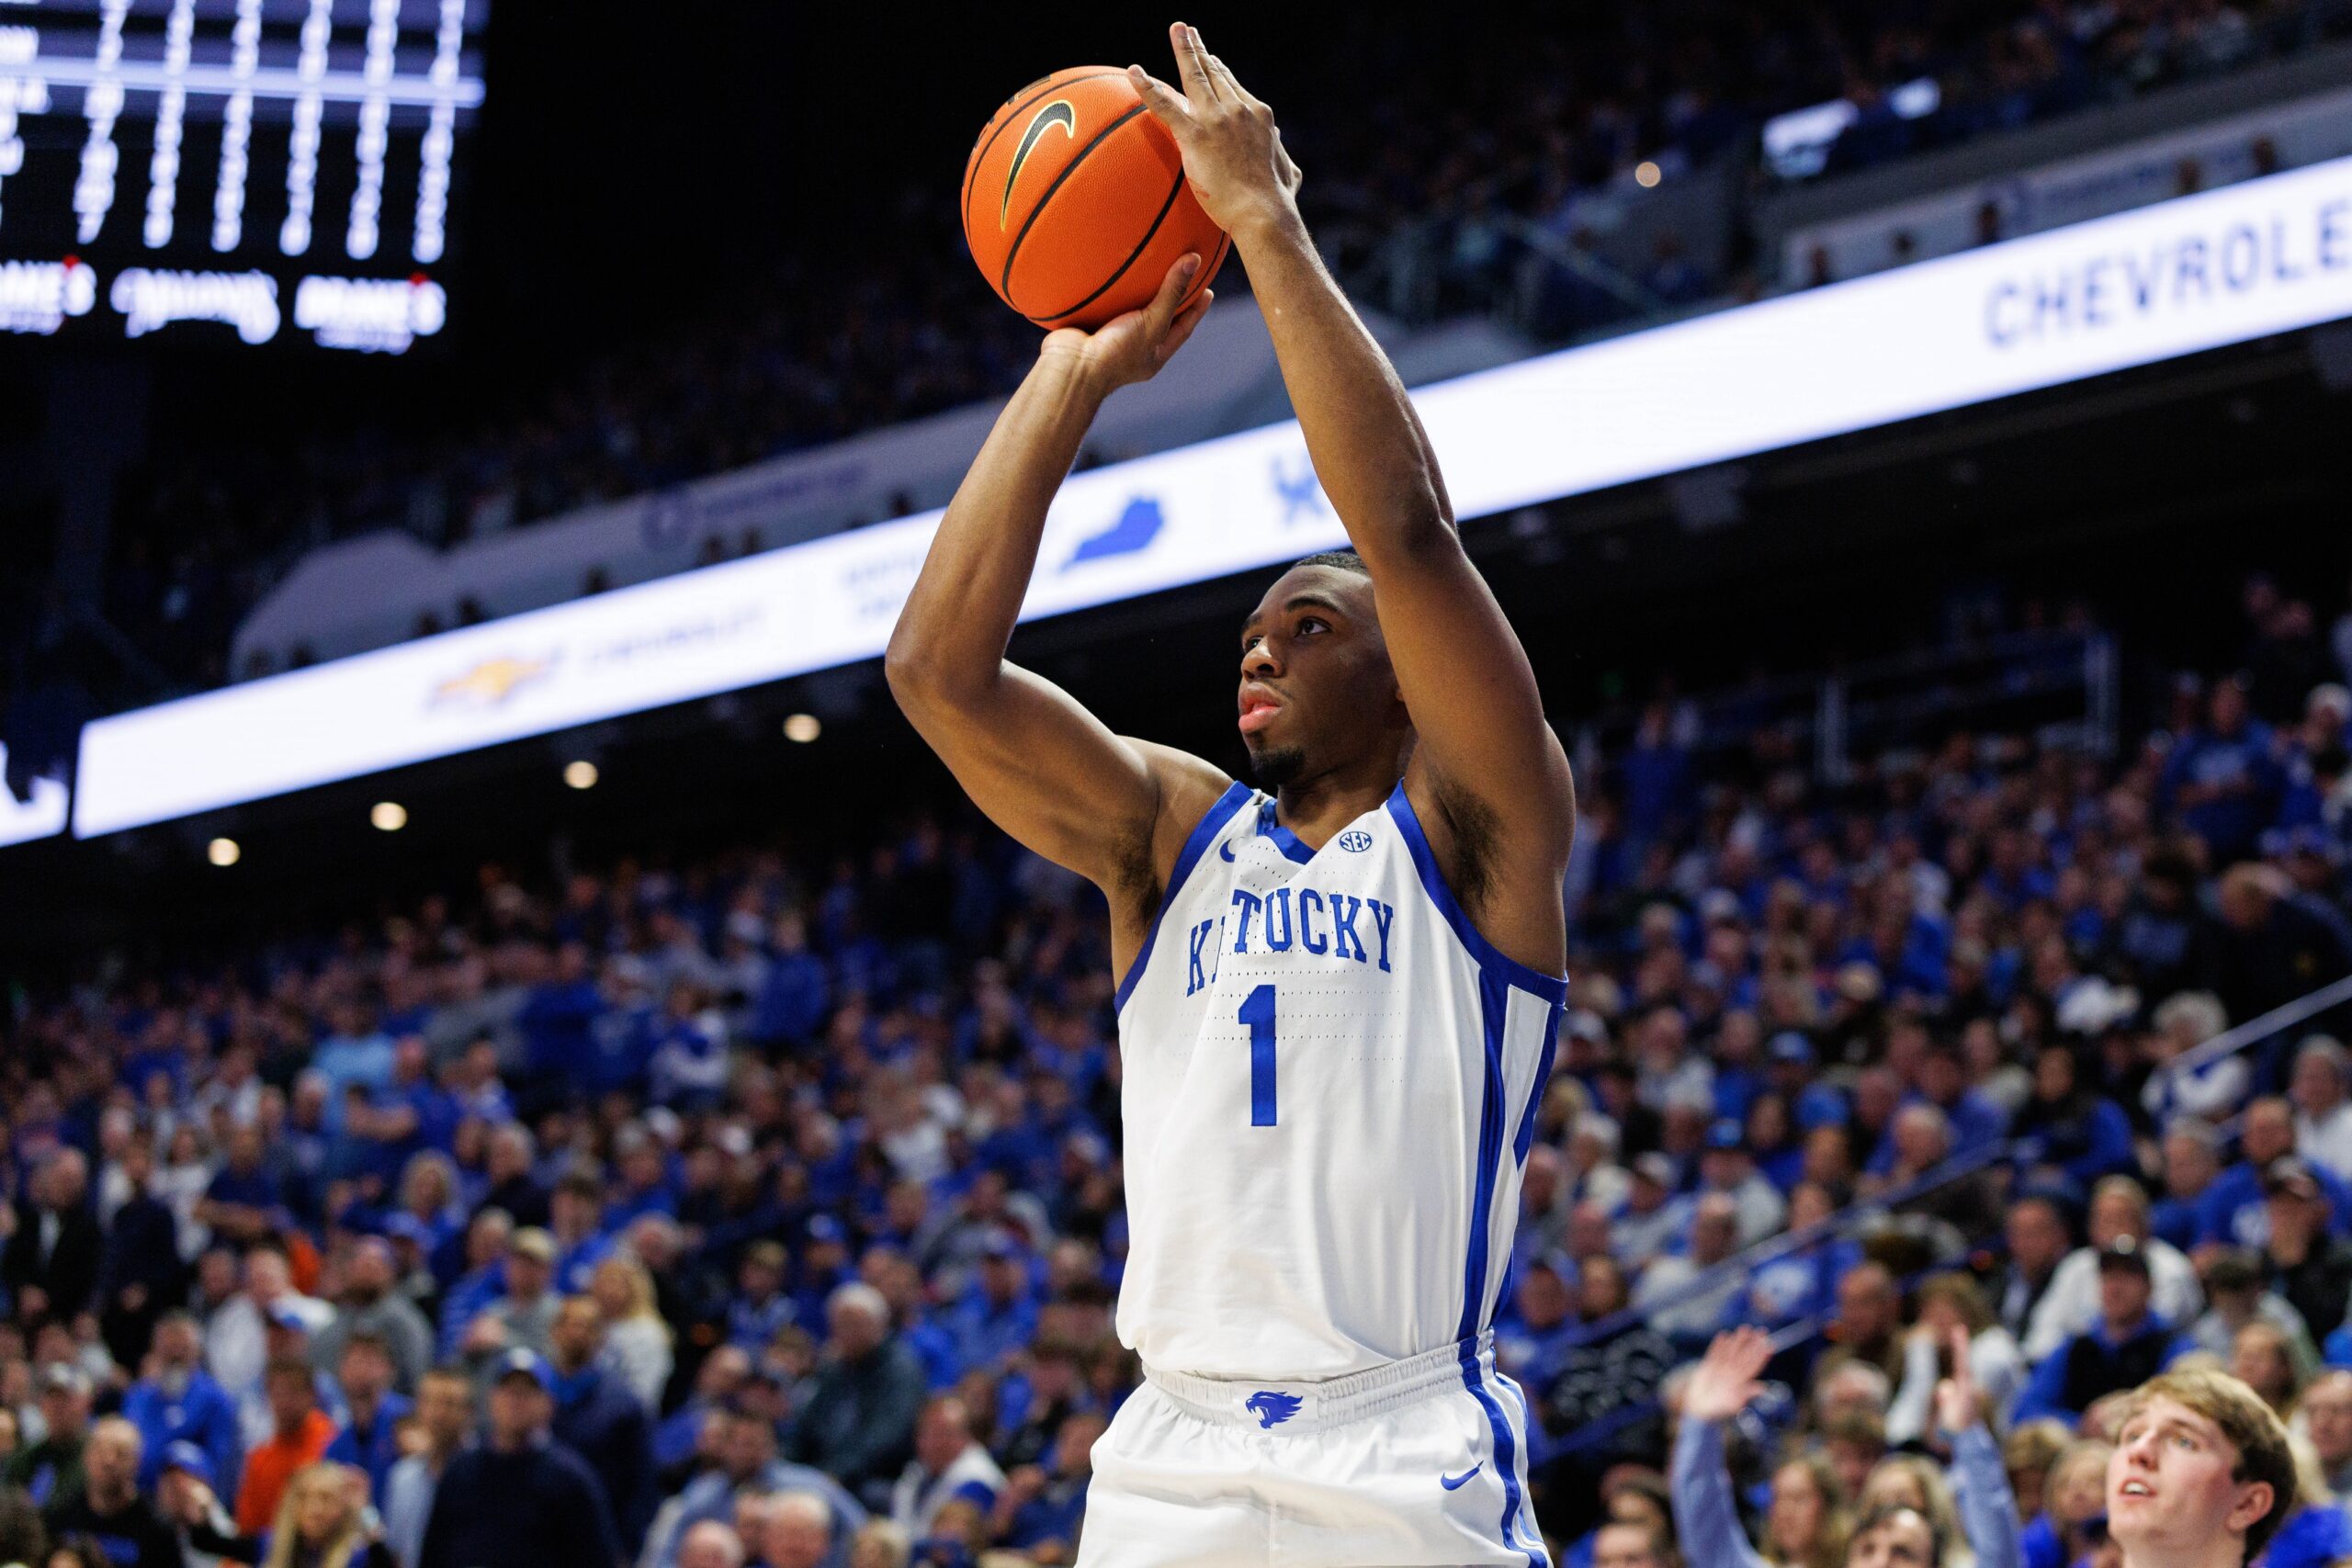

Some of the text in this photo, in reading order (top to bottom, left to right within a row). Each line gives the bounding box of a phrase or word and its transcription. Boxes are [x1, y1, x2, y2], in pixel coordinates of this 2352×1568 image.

[1340, 831, 1371, 852] SEC
[1187, 887, 1394, 998] KTUCKY
[1238, 984, 1277, 1126] 1
